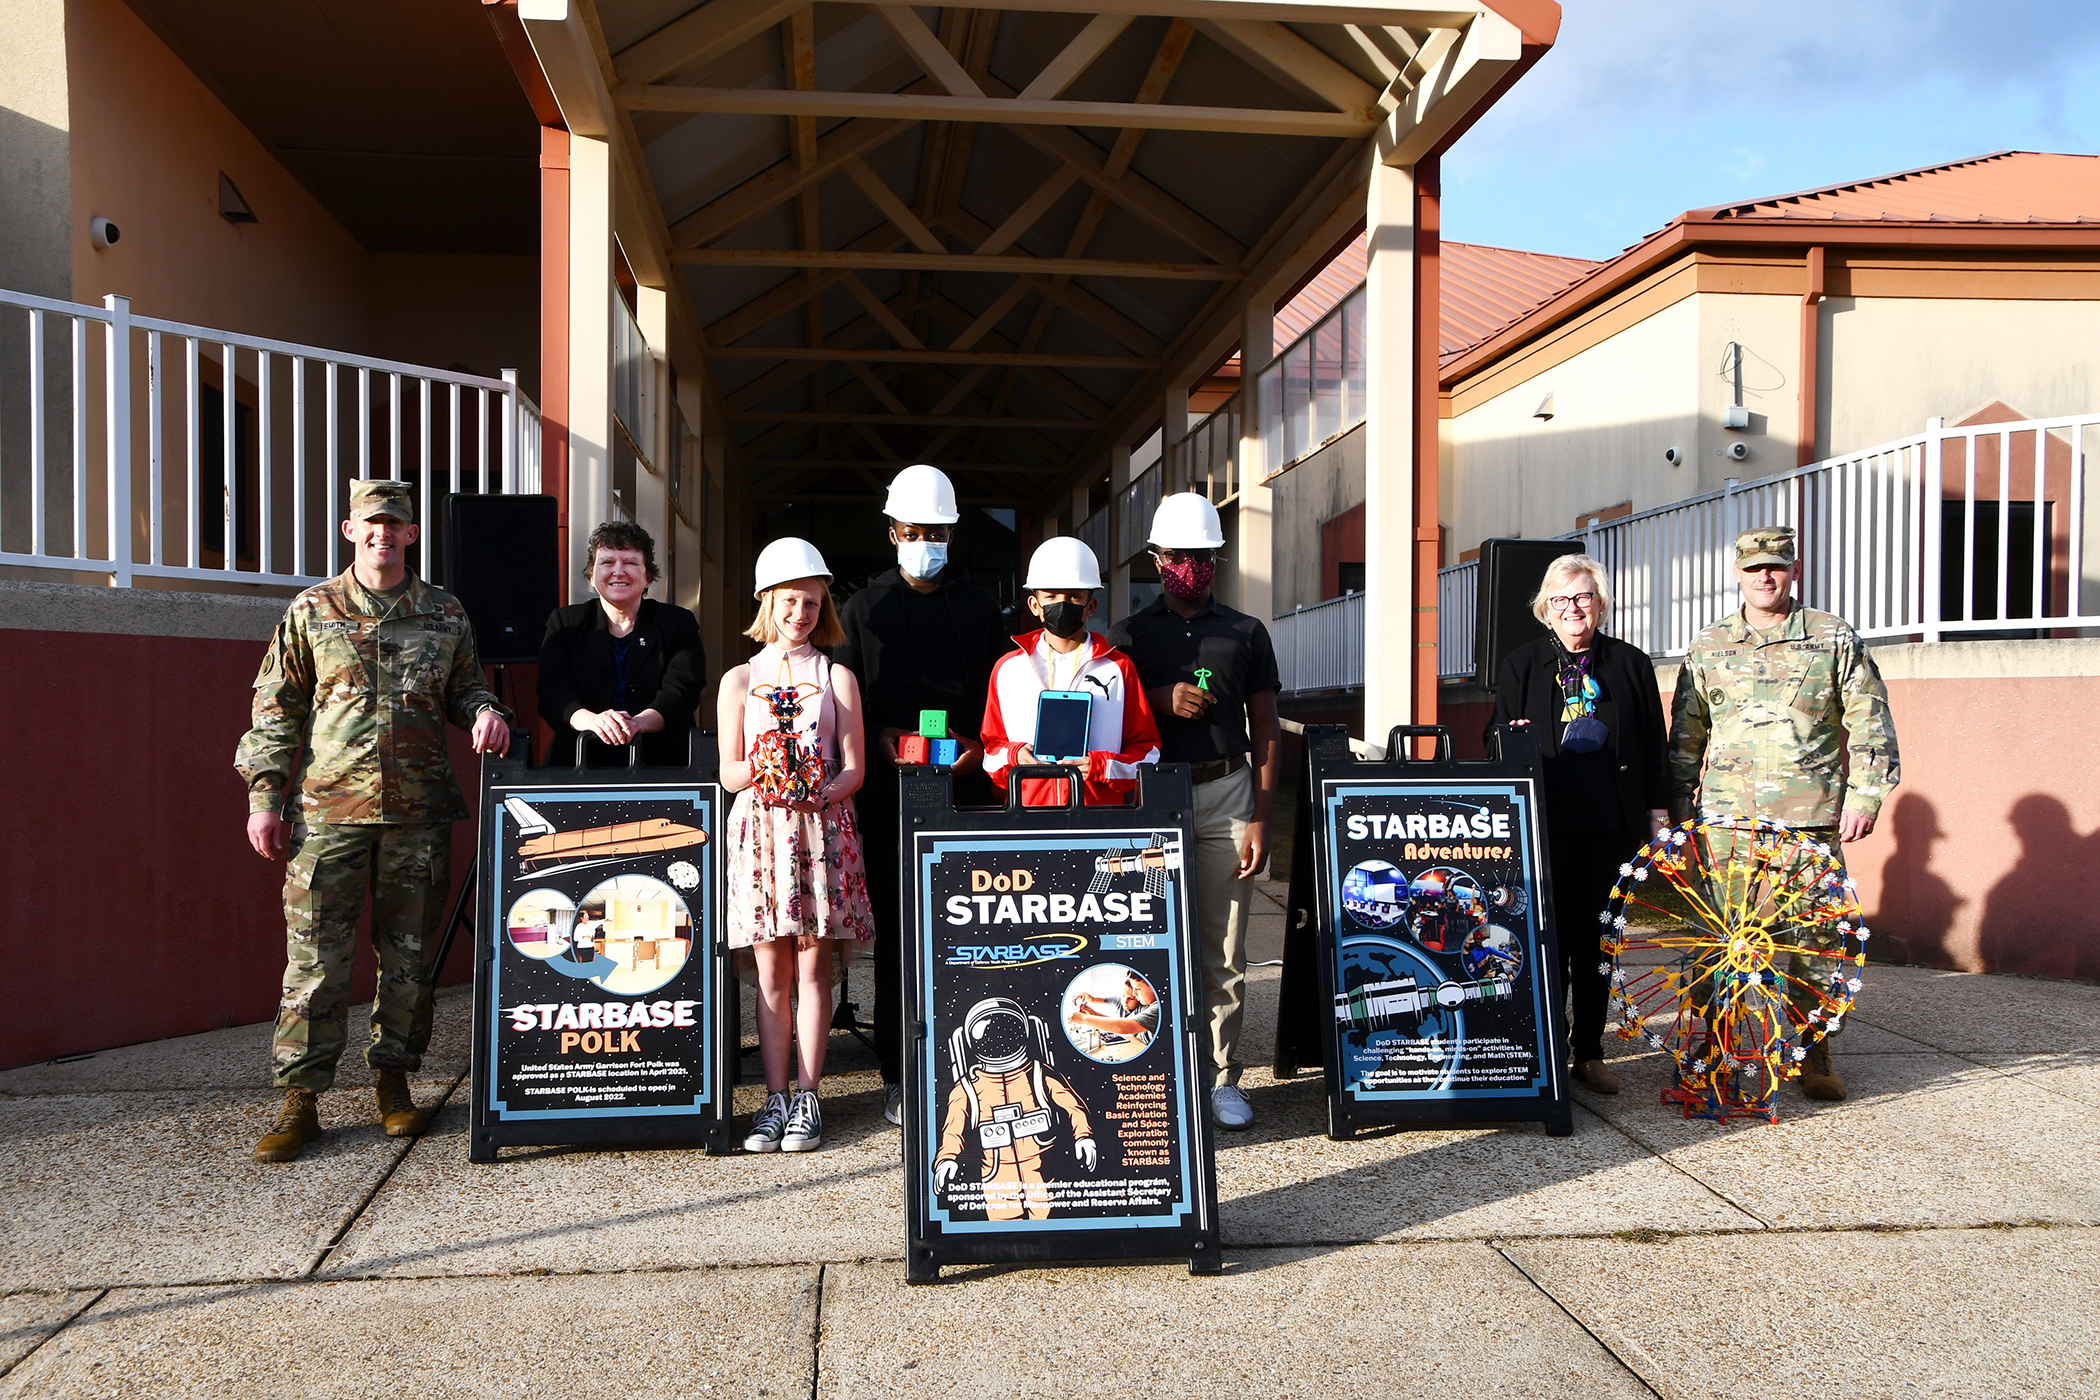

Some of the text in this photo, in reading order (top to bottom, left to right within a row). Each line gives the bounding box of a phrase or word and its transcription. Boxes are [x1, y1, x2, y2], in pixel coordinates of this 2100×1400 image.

[324, 621, 346, 630] SMITH
[435, 622, 452, 632] ARMY
[1346, 813, 1511, 840] STARBASE
[1404, 842, 1512, 860] Adventures
[972, 869, 1034, 892] DoD
[946, 892, 1154, 926] STARBASE
[1116, 936, 1154, 948] STEM
[946, 944, 1080, 960] STARBASE
[509, 1000, 701, 1032] STARBASE
[561, 1030, 642, 1054] POLK
[521, 1064, 547, 1072] United
[574, 1063, 595, 1071] Army
[1112, 1073, 1165, 1082] Science and
[525, 1087, 566, 1095] STARBASE
[1116, 1083, 1166, 1092] Technology
[575, 1094, 602, 1102] August
[1118, 1092, 1166, 1100] Academies
[1116, 1101, 1167, 1110] Reinforcing
[1105, 1111, 1167, 1119] Basic Aviation
[1140, 1120, 1168, 1129] Space
[1118, 1130, 1168, 1139] Exploration
[1123, 1138, 1169, 1147] commonly
[1122, 1157, 1170, 1166] STARBASE
[948, 1183, 968, 1192] DoD
[969, 1182, 1018, 1191] STARBASE
[1036, 1180, 1072, 1190] premier
[1073, 1178, 1127, 1188] educational
[1128, 1178, 1170, 1188] program,
[947, 1192, 996, 1202] sponsored
[998, 1192, 1008, 1200] by
[1026, 1190, 1054, 1199] Office
[1055, 1190, 1065, 1198] of
[1083, 1188, 1126, 1197] Assistant
[1127, 1187, 1172, 1196] Secretary
[958, 1202, 968, 1210] of
[969, 1201, 1007, 1210] Defense
[1023, 1200, 1070, 1210] Manpower
[1071, 1199, 1089, 1207] and
[1091, 1198, 1127, 1207] Reserve
[1129, 1196, 1161, 1206] Affairs.
